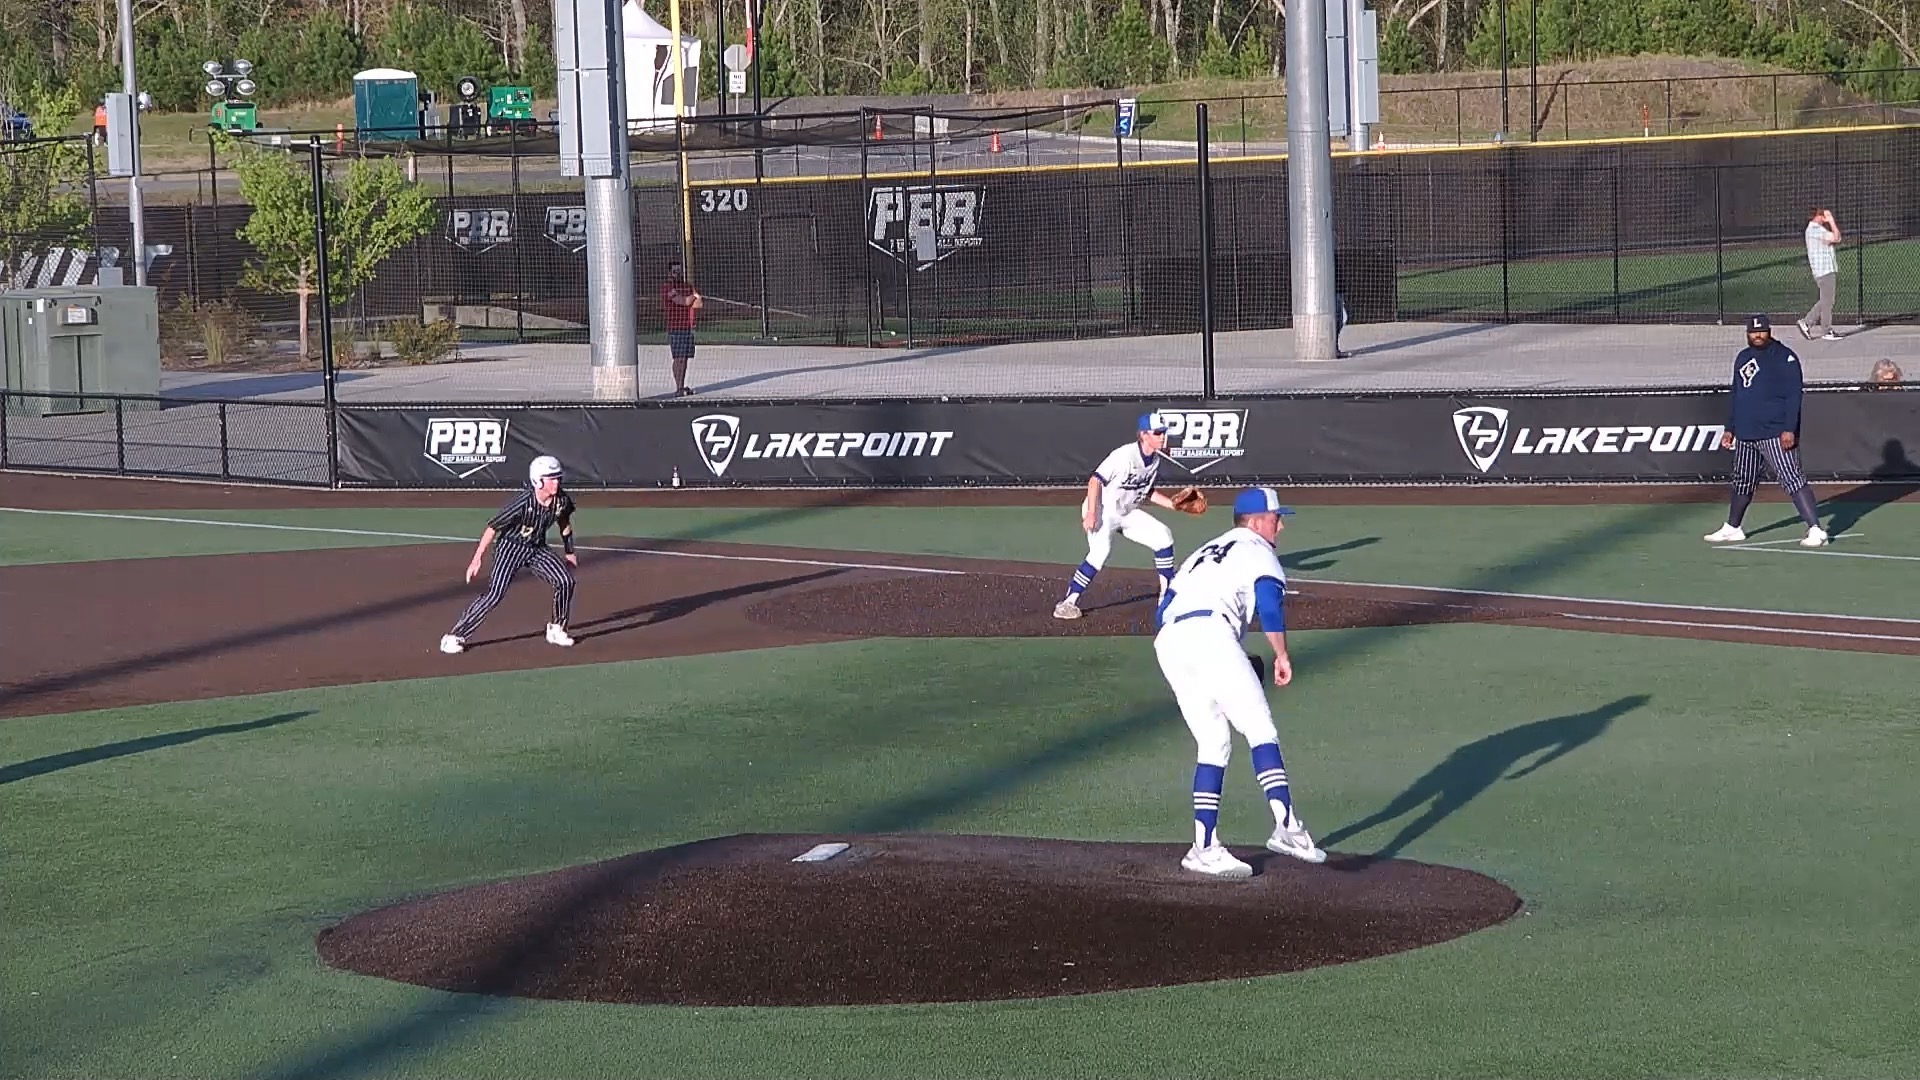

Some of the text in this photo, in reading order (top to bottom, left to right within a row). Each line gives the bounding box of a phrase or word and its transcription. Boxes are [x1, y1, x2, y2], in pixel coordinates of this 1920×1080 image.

[700, 189, 748, 212] 320
[453, 210, 510, 238] PBR
[547, 209, 586, 235] PB
[874, 190, 977, 240] PBR
[1753, 318, 1762, 328] L
[430, 421, 502, 455] PBR
[1160, 413, 1240, 448] PBR
[1512, 425, 1736, 454] LAKEPOIN
[485, 455, 507, 463] REPORT
[742, 431, 954, 459] LAKEPOINT
[1220, 448, 1245, 457] REPORT
